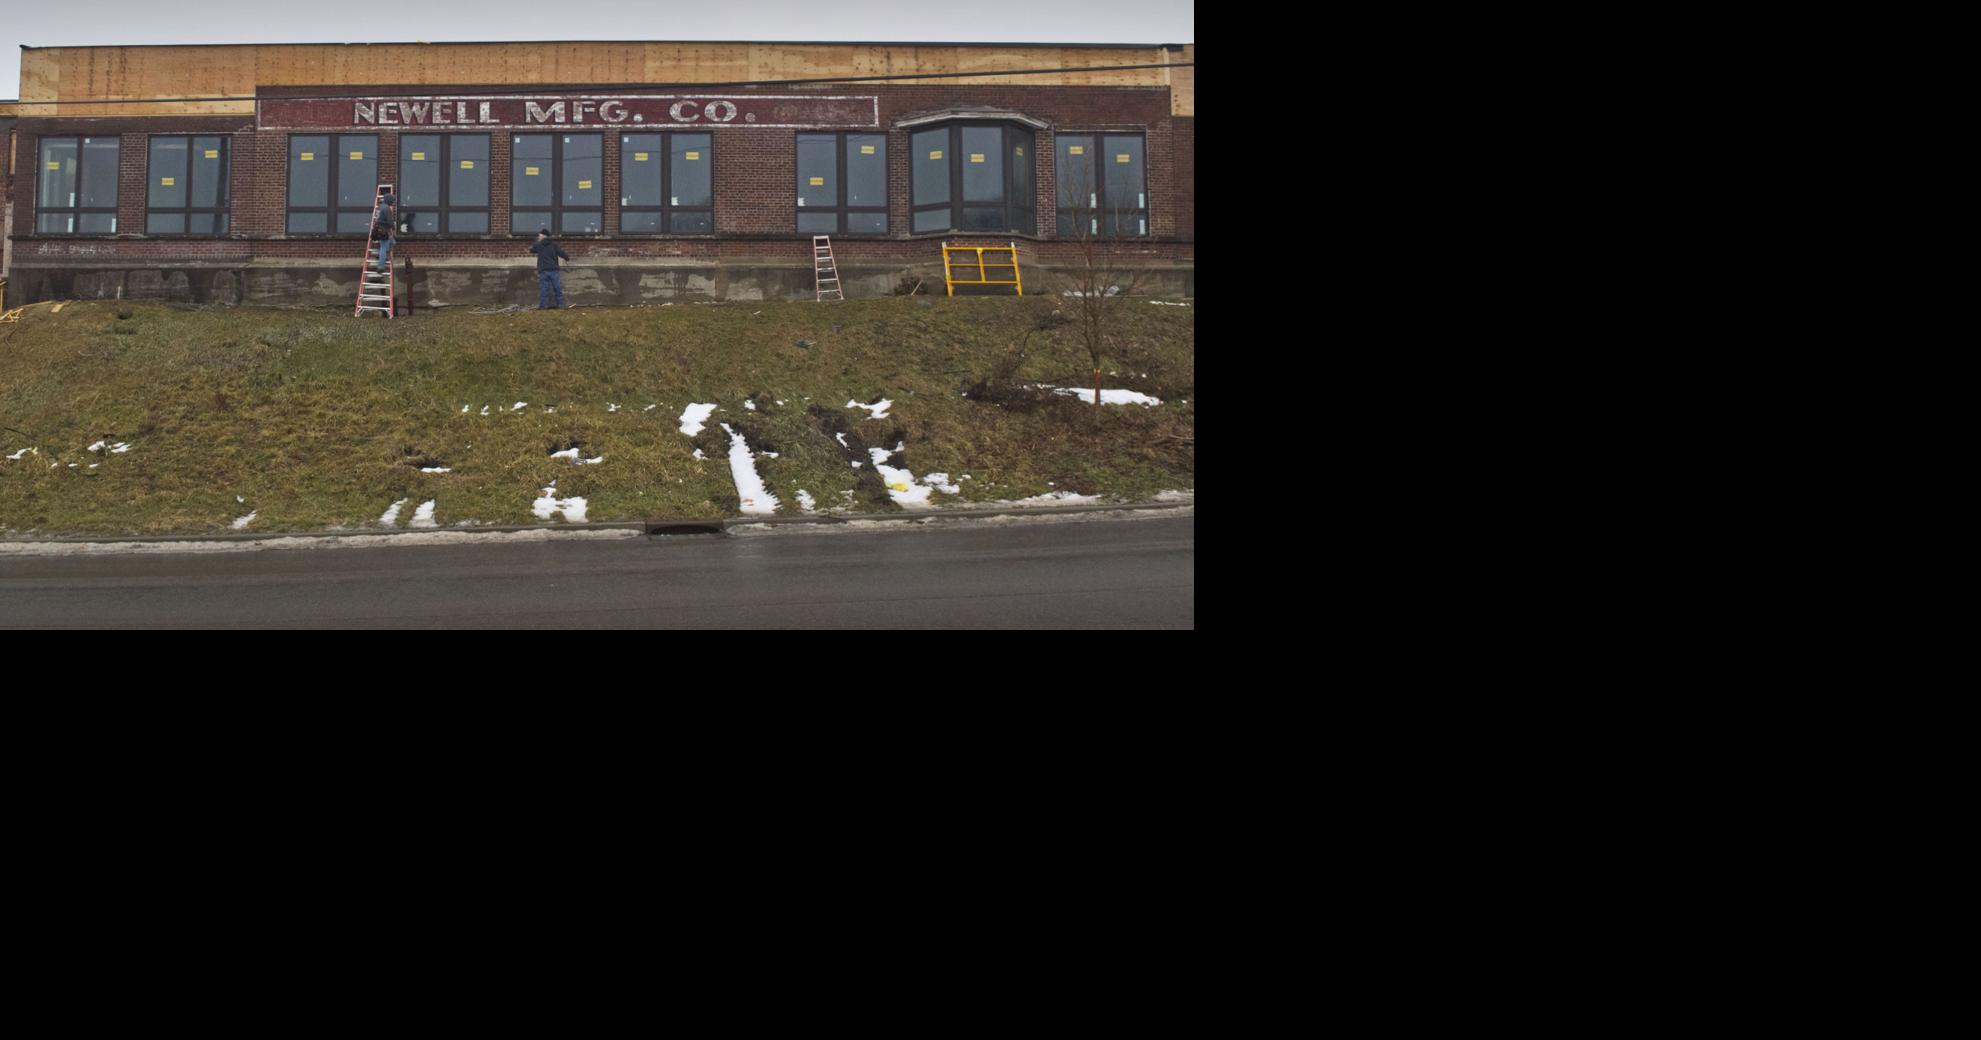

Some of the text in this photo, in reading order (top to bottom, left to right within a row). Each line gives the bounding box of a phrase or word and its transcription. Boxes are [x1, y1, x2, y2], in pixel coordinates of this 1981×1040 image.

[354, 101, 500, 124] NEWELL
[525, 101, 643, 123] MFG.
[669, 100, 756, 122] CO.
